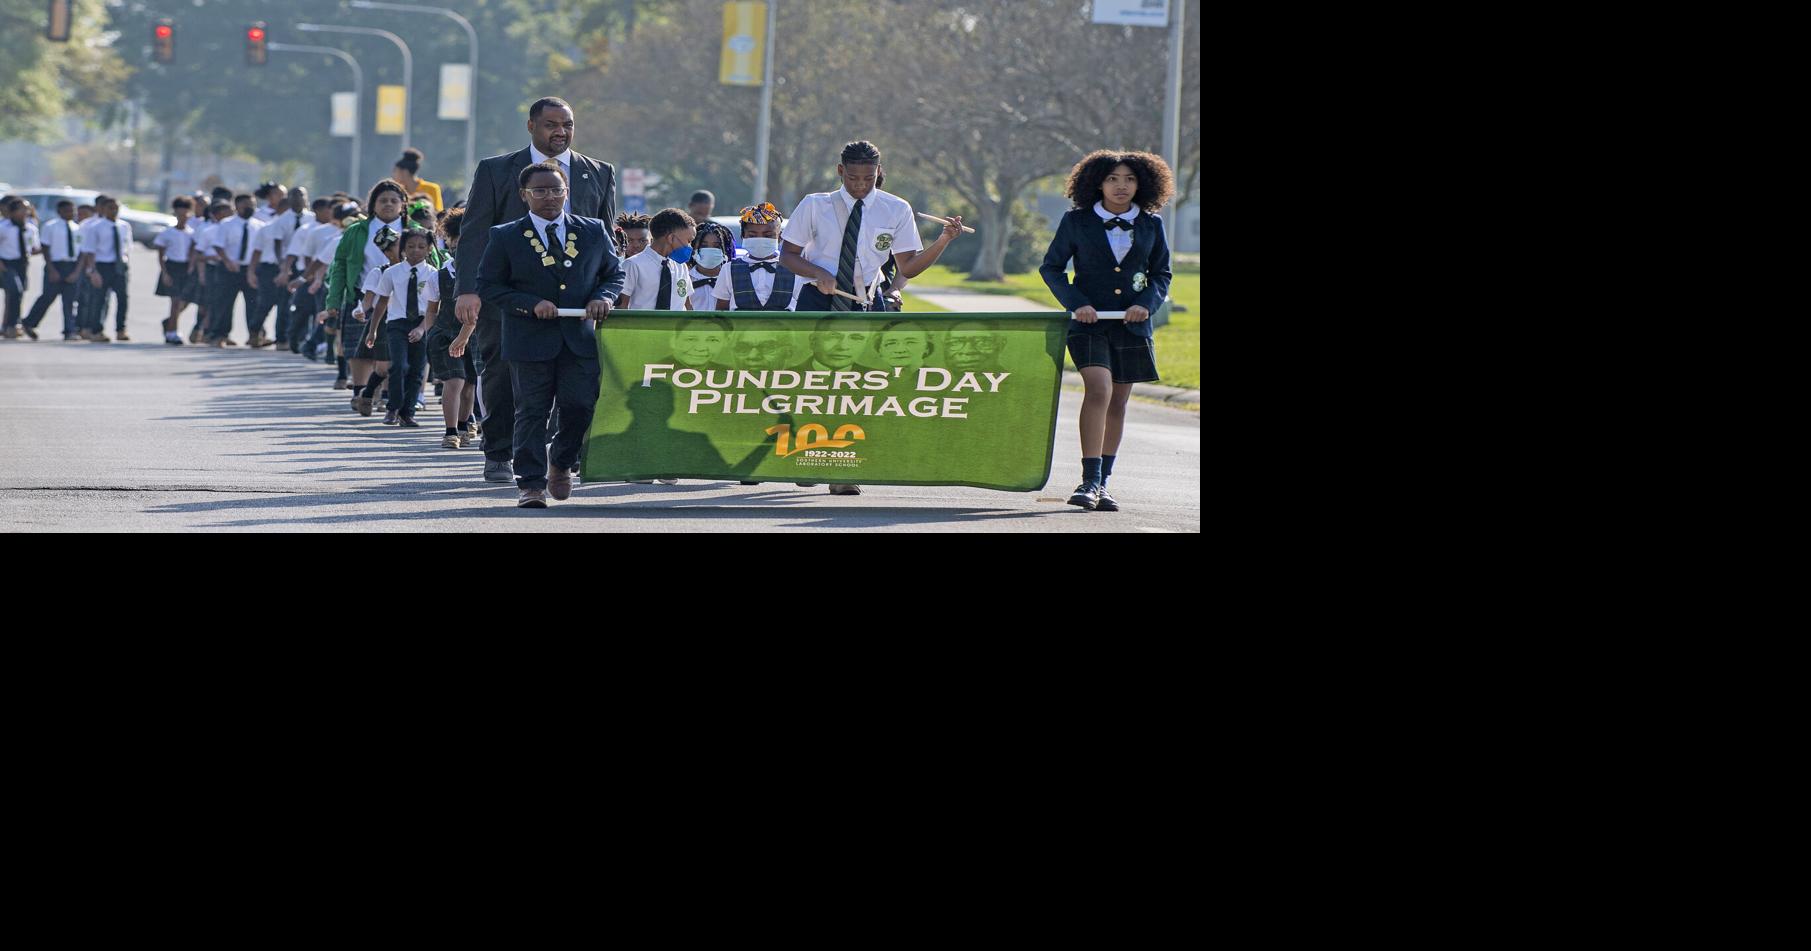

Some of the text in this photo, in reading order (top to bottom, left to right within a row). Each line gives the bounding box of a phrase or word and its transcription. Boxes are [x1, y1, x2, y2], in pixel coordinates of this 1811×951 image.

[641, 363, 1012, 393] FOUNDERS' DAY
[687, 389, 970, 419] PILGRIMAGE
[765, 423, 866, 457] 100
[804, 450, 857, 459] 1922-2022
